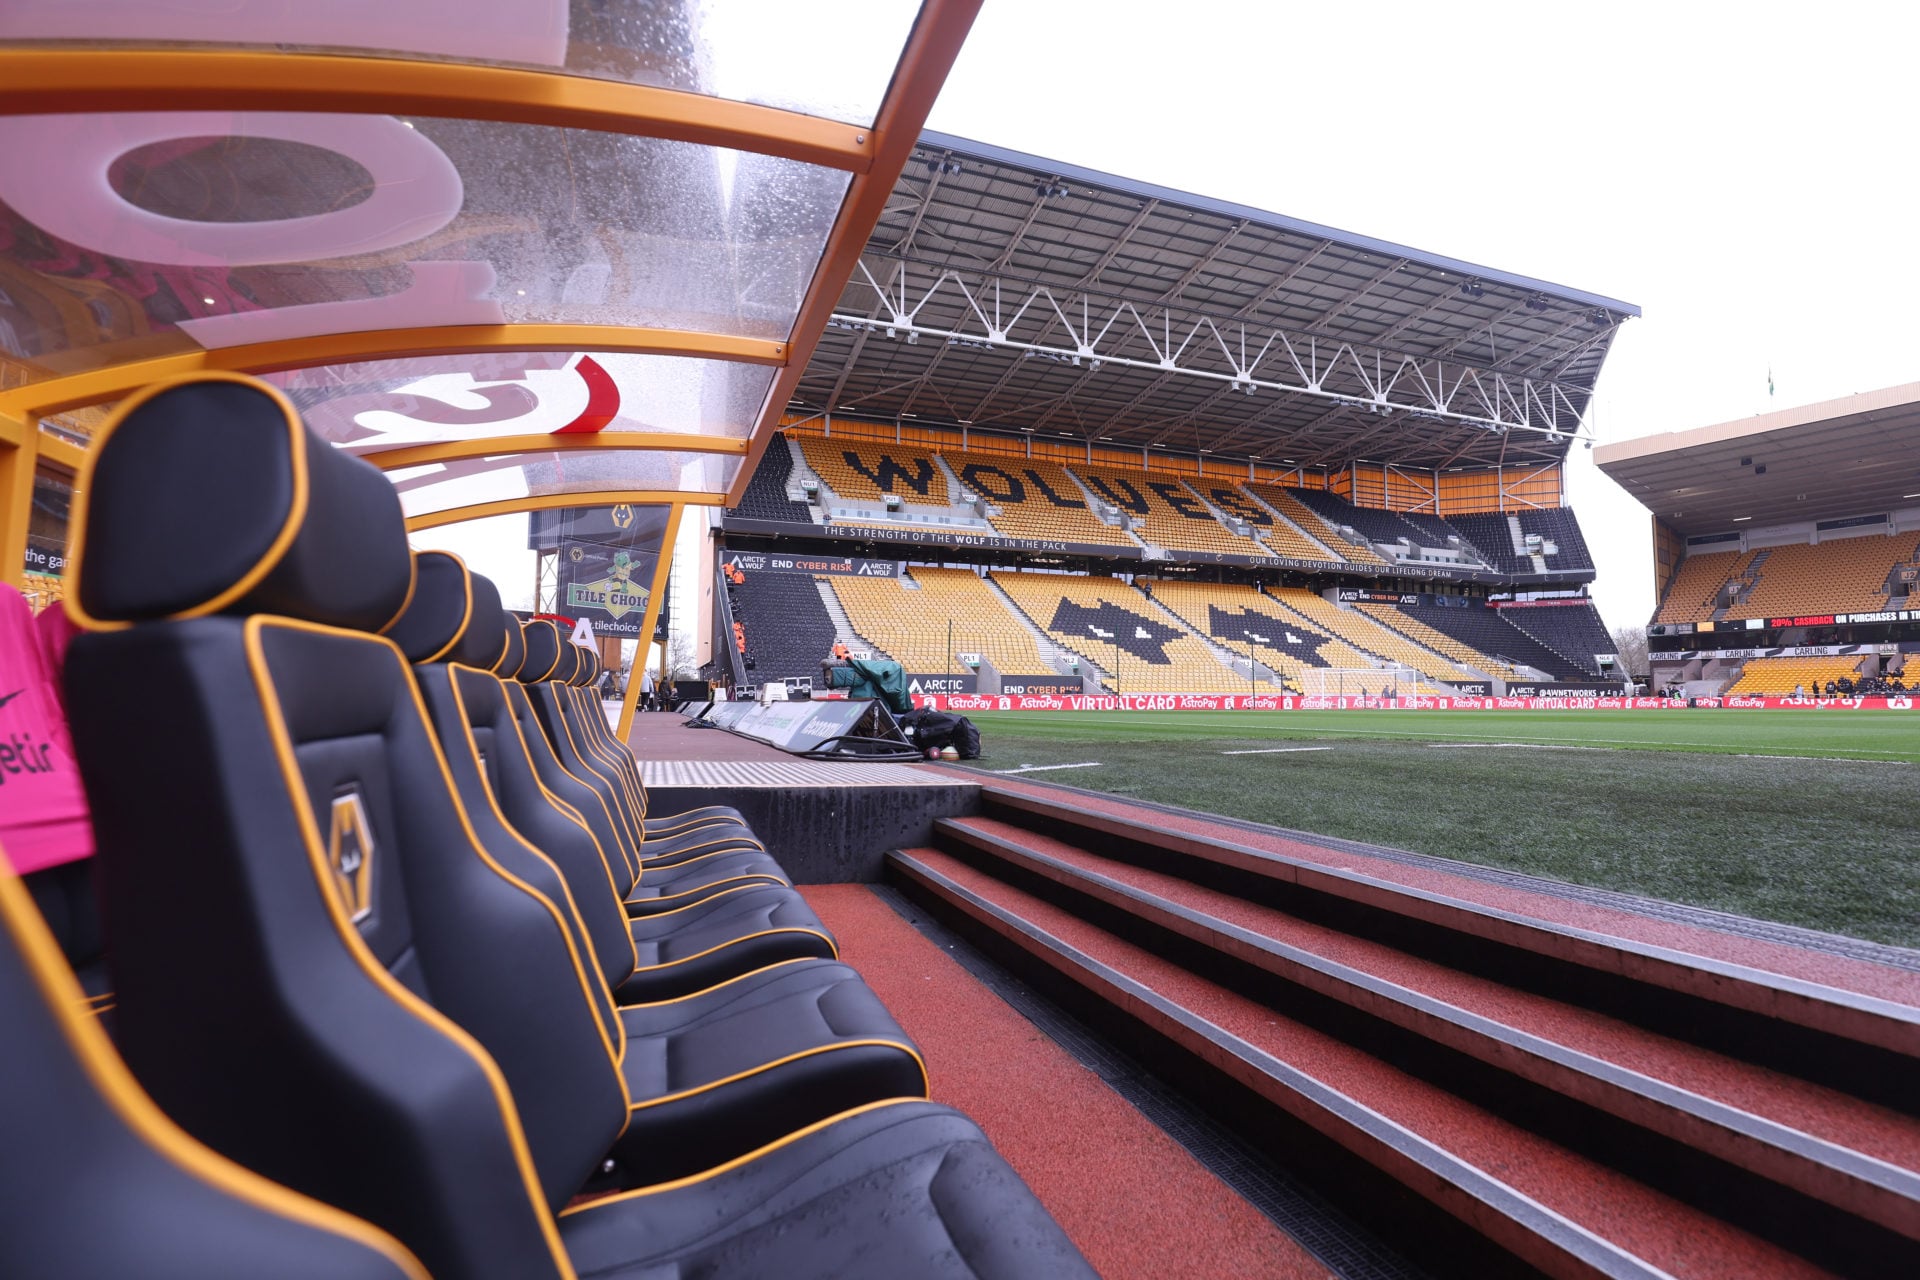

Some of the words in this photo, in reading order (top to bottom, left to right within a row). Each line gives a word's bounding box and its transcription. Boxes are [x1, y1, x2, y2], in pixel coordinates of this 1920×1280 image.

[824, 526, 845, 536] THE
[850, 528, 907, 539] STRENGTH
[912, 533, 926, 541] OF
[931, 533, 951, 543] THE
[955, 535, 985, 545] WOLF
[989, 539, 1000, 547] IS
[1020, 540, 1039, 549] THE
[1042, 541, 1067, 550] PACK
[25, 548, 46, 564] the
[771, 559, 793, 569] END
[796, 561, 828, 571] CYBER
[830, 563, 853, 572] RISK
[1249, 556, 1266, 565] OUR
[1269, 559, 1299, 567] LOVING
[1302, 561, 1341, 570] DEVOTION
[1344, 563, 1372, 572] GUIDES
[1375, 565, 1390, 573] OUR
[1392, 567, 1426, 576] LIFELONG
[1428, 569, 1452, 578] DREAM
[1904, 571, 1915, 579] J2
[576, 590, 605, 603] TILE
[610, 593, 649, 607] CHOIC
[1771, 618, 1792, 628] 20%
[1794, 615, 1834, 626] CASHBACK
[1835, 614, 1847, 624] ON
[1849, 612, 1897, 623] PURCHASES
[1898, 611, 1908, 621] IN
[1650, 652, 1679, 661] CARLING
[1725, 649, 1756, 658] CARLING
[1794, 646, 1828, 656] CARLING
[924, 679, 963, 690] ARCTIC
[1004, 685, 1024, 694] END
[1026, 685, 1057, 694] CYBER
[1461, 685, 1484, 694] ARCTIC
[1539, 689, 1597, 697] @AWNETWORKS
[948, 697, 992, 710] AstroPay
[1020, 697, 1063, 710] AstroPay
[1071, 697, 1132, 710] VIRTUAL
[1136, 697, 1175, 710] CARD
[1180, 697, 1218, 709] AstroPay
[1242, 699, 1277, 710] AstroPay
[1453, 699, 1481, 708] AstroPay
[1497, 699, 1525, 709] AstroPay
[1529, 698, 1567, 709] VIRTUAL
[1569, 698, 1595, 709] CARD
[1598, 699, 1621, 708] AstroPay
[1636, 699, 1659, 708] AstroPay
[1729, 699, 1765, 709] AstroPay
[0, 732, 55, 786] etir
